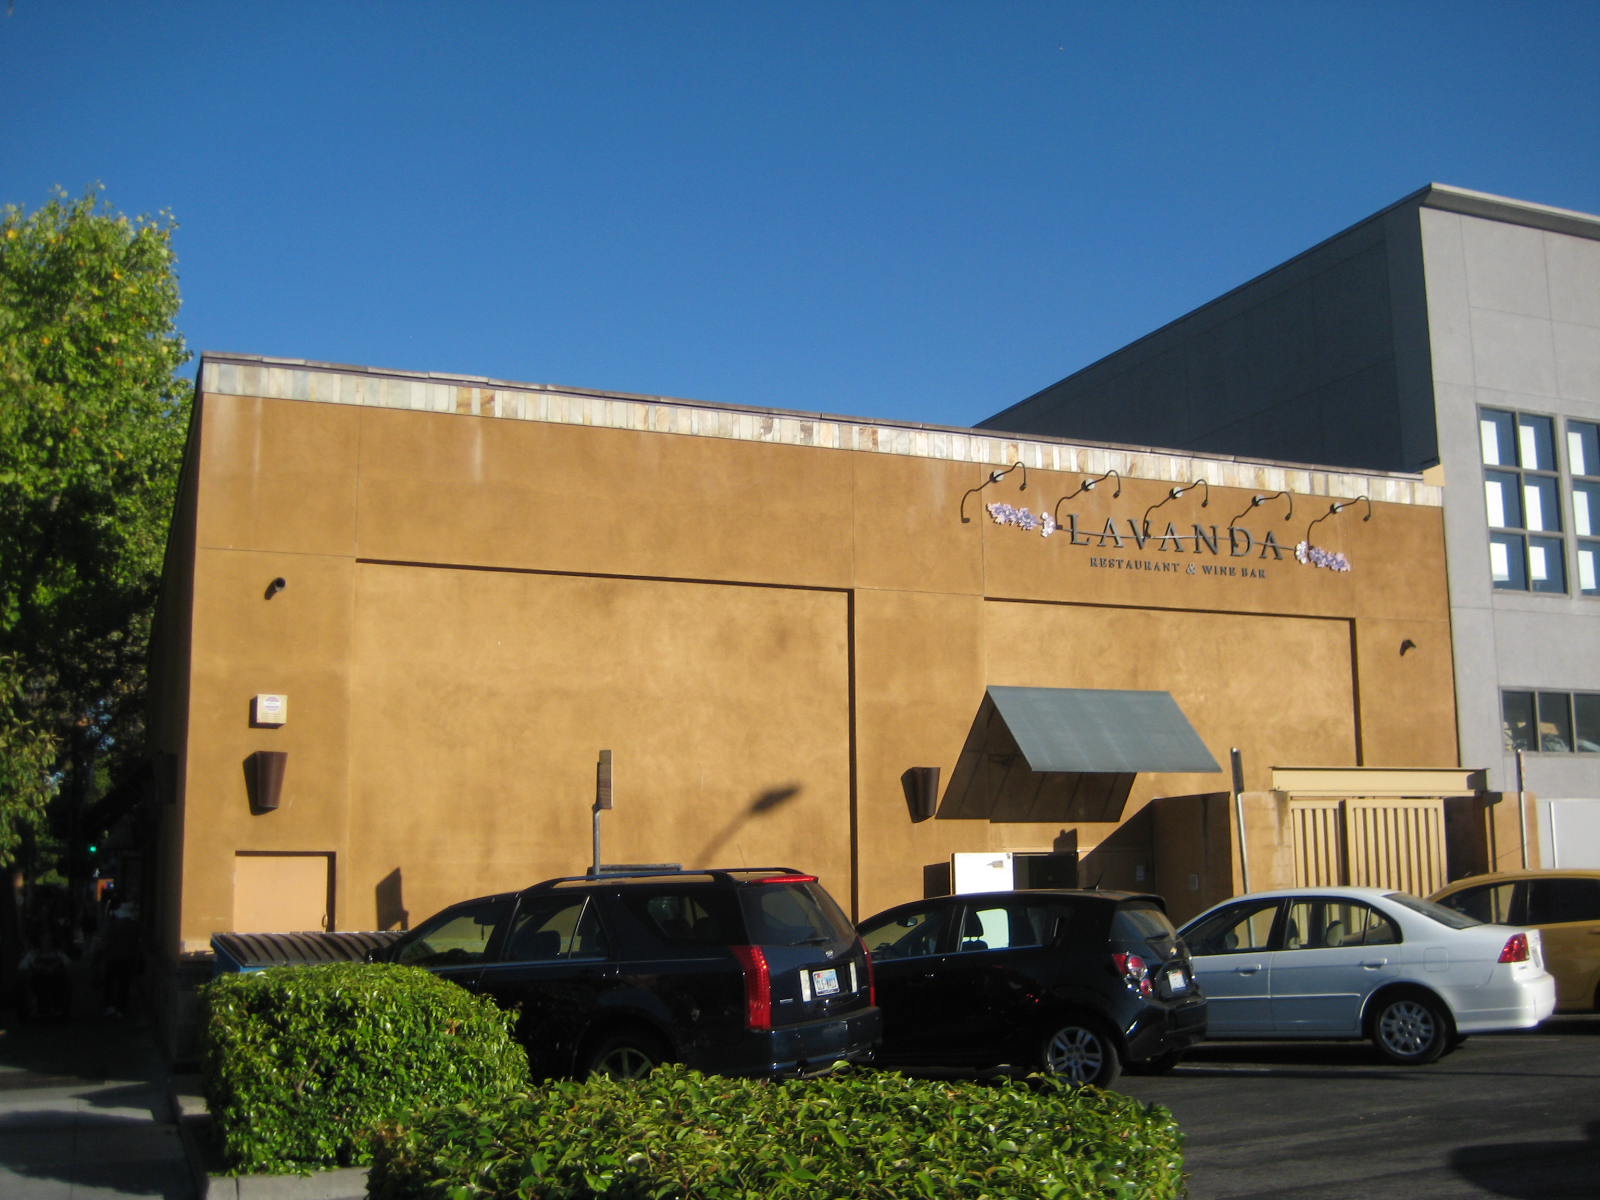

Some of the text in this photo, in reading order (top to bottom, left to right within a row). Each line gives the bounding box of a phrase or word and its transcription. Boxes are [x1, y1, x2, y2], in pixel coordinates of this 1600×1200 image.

[1068, 513, 1283, 560] LAVANDA
[1090, 557, 1267, 579] RESTAURANT & WINE BAR
